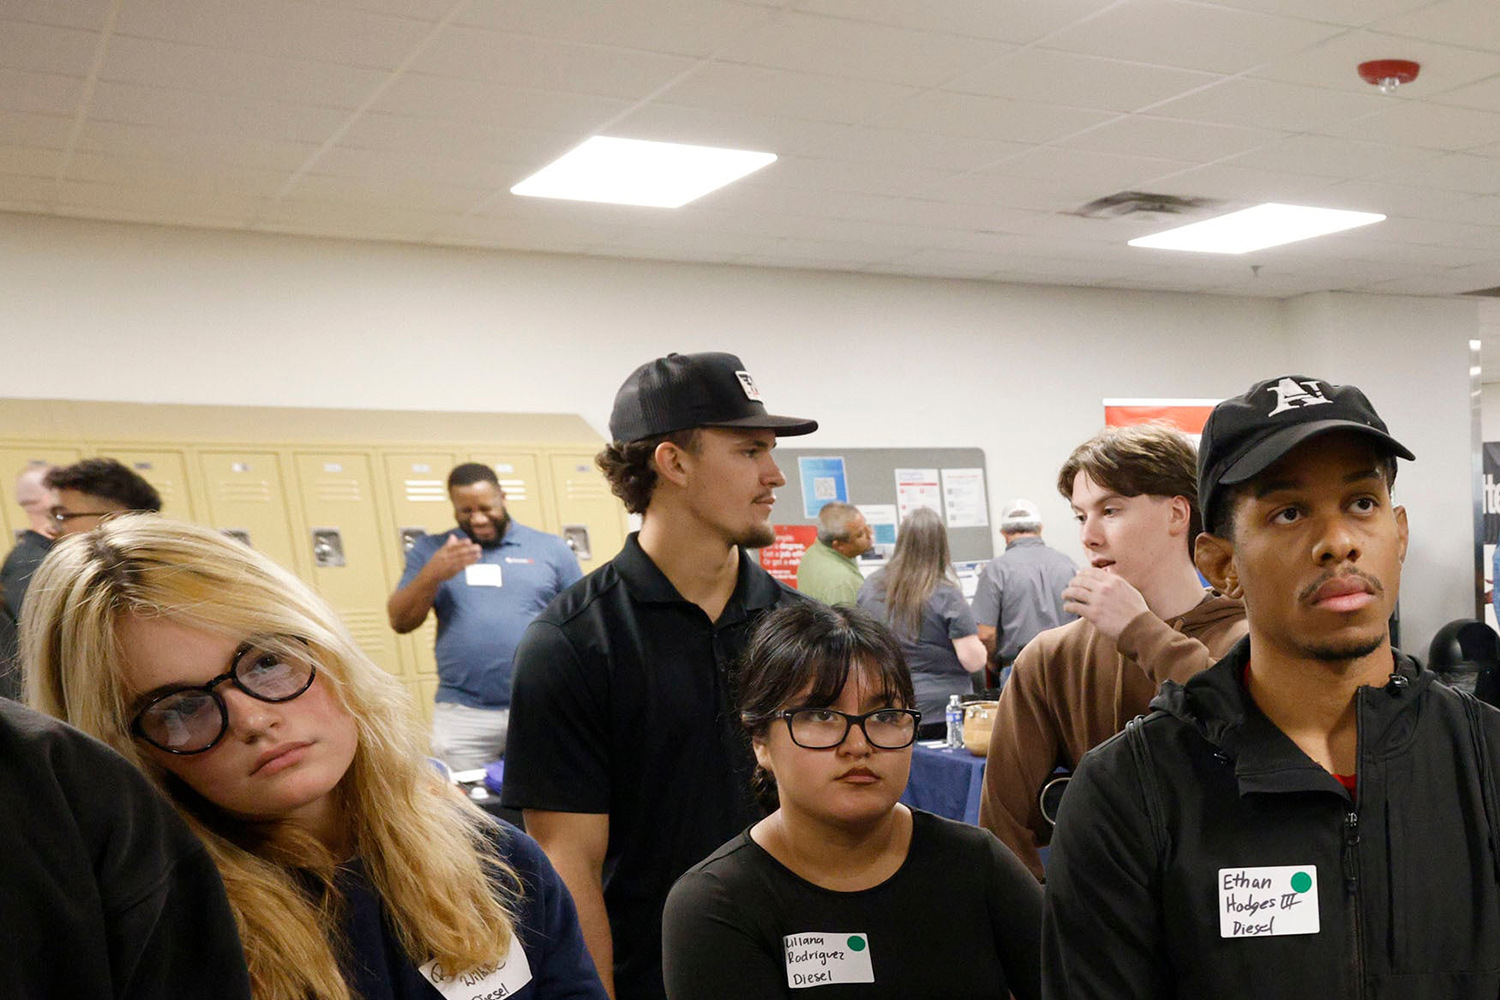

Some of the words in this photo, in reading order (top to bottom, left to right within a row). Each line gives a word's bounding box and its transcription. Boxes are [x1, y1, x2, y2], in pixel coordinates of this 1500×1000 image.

[1223, 870, 1272, 890] Ethan
[1226, 893, 1276, 917] Hodges
[1233, 916, 1275, 935] Diesel
[787, 950, 845, 966] Rodriguez
[793, 970, 832, 985] Diesel
